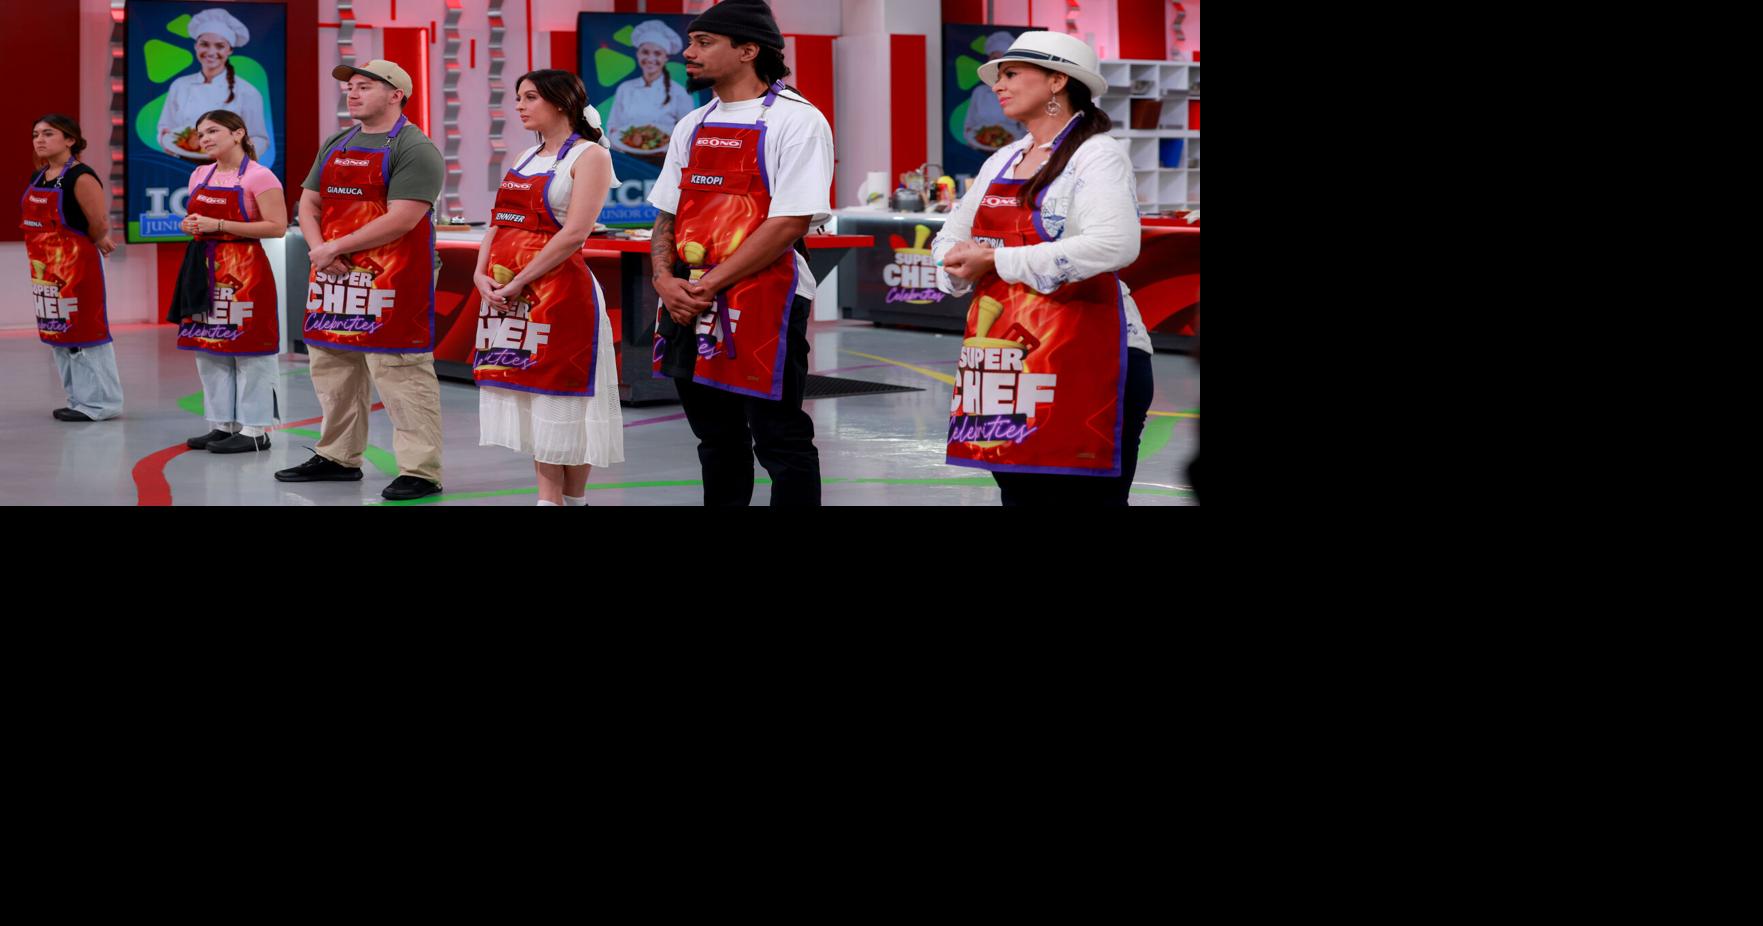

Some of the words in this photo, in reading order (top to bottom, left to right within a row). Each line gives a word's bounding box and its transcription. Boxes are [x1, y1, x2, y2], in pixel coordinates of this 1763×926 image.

[695, 138, 742, 149] ECONO
[327, 186, 363, 196] GIANLUCA
[501, 181, 532, 190] CONO
[691, 174, 723, 186] KEROPI
[882, 263, 937, 289] CHE
[33, 293, 78, 320] HEF
[306, 281, 396, 318] CHEF
[303, 312, 383, 334] Celebrities
[475, 317, 551, 355] HEF
[958, 346, 1024, 371] SUPER
